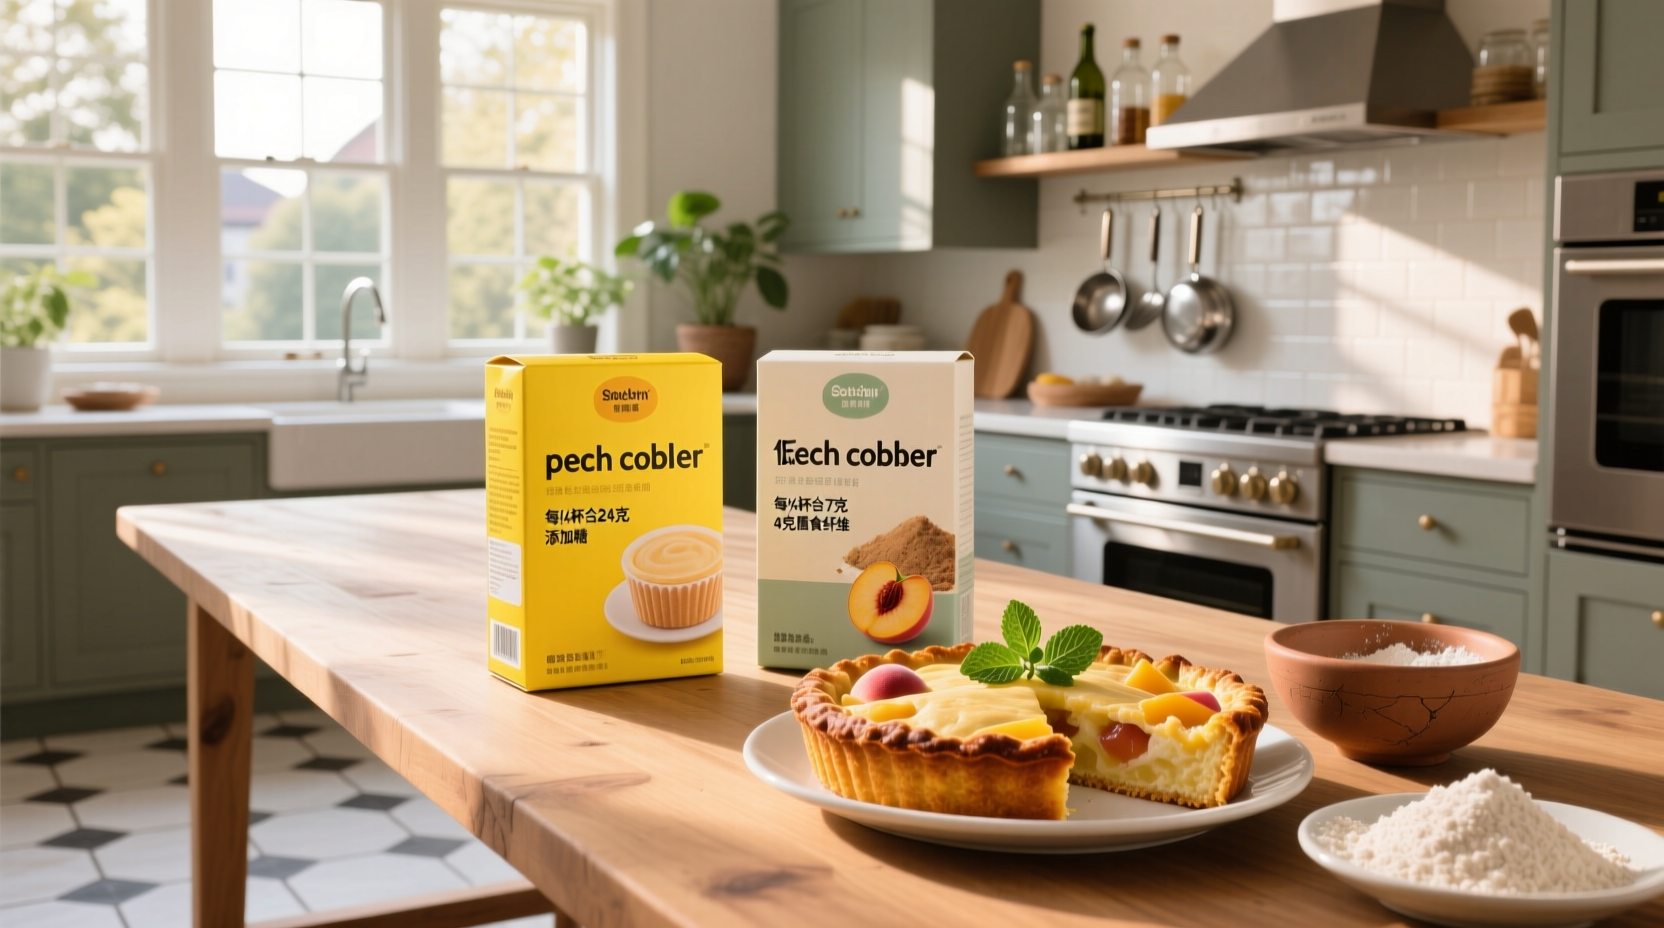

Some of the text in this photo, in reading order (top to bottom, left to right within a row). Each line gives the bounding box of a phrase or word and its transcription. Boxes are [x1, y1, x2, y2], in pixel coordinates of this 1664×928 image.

[546, 442, 703, 480] pech cobler
[846, 440, 938, 467] cobber
